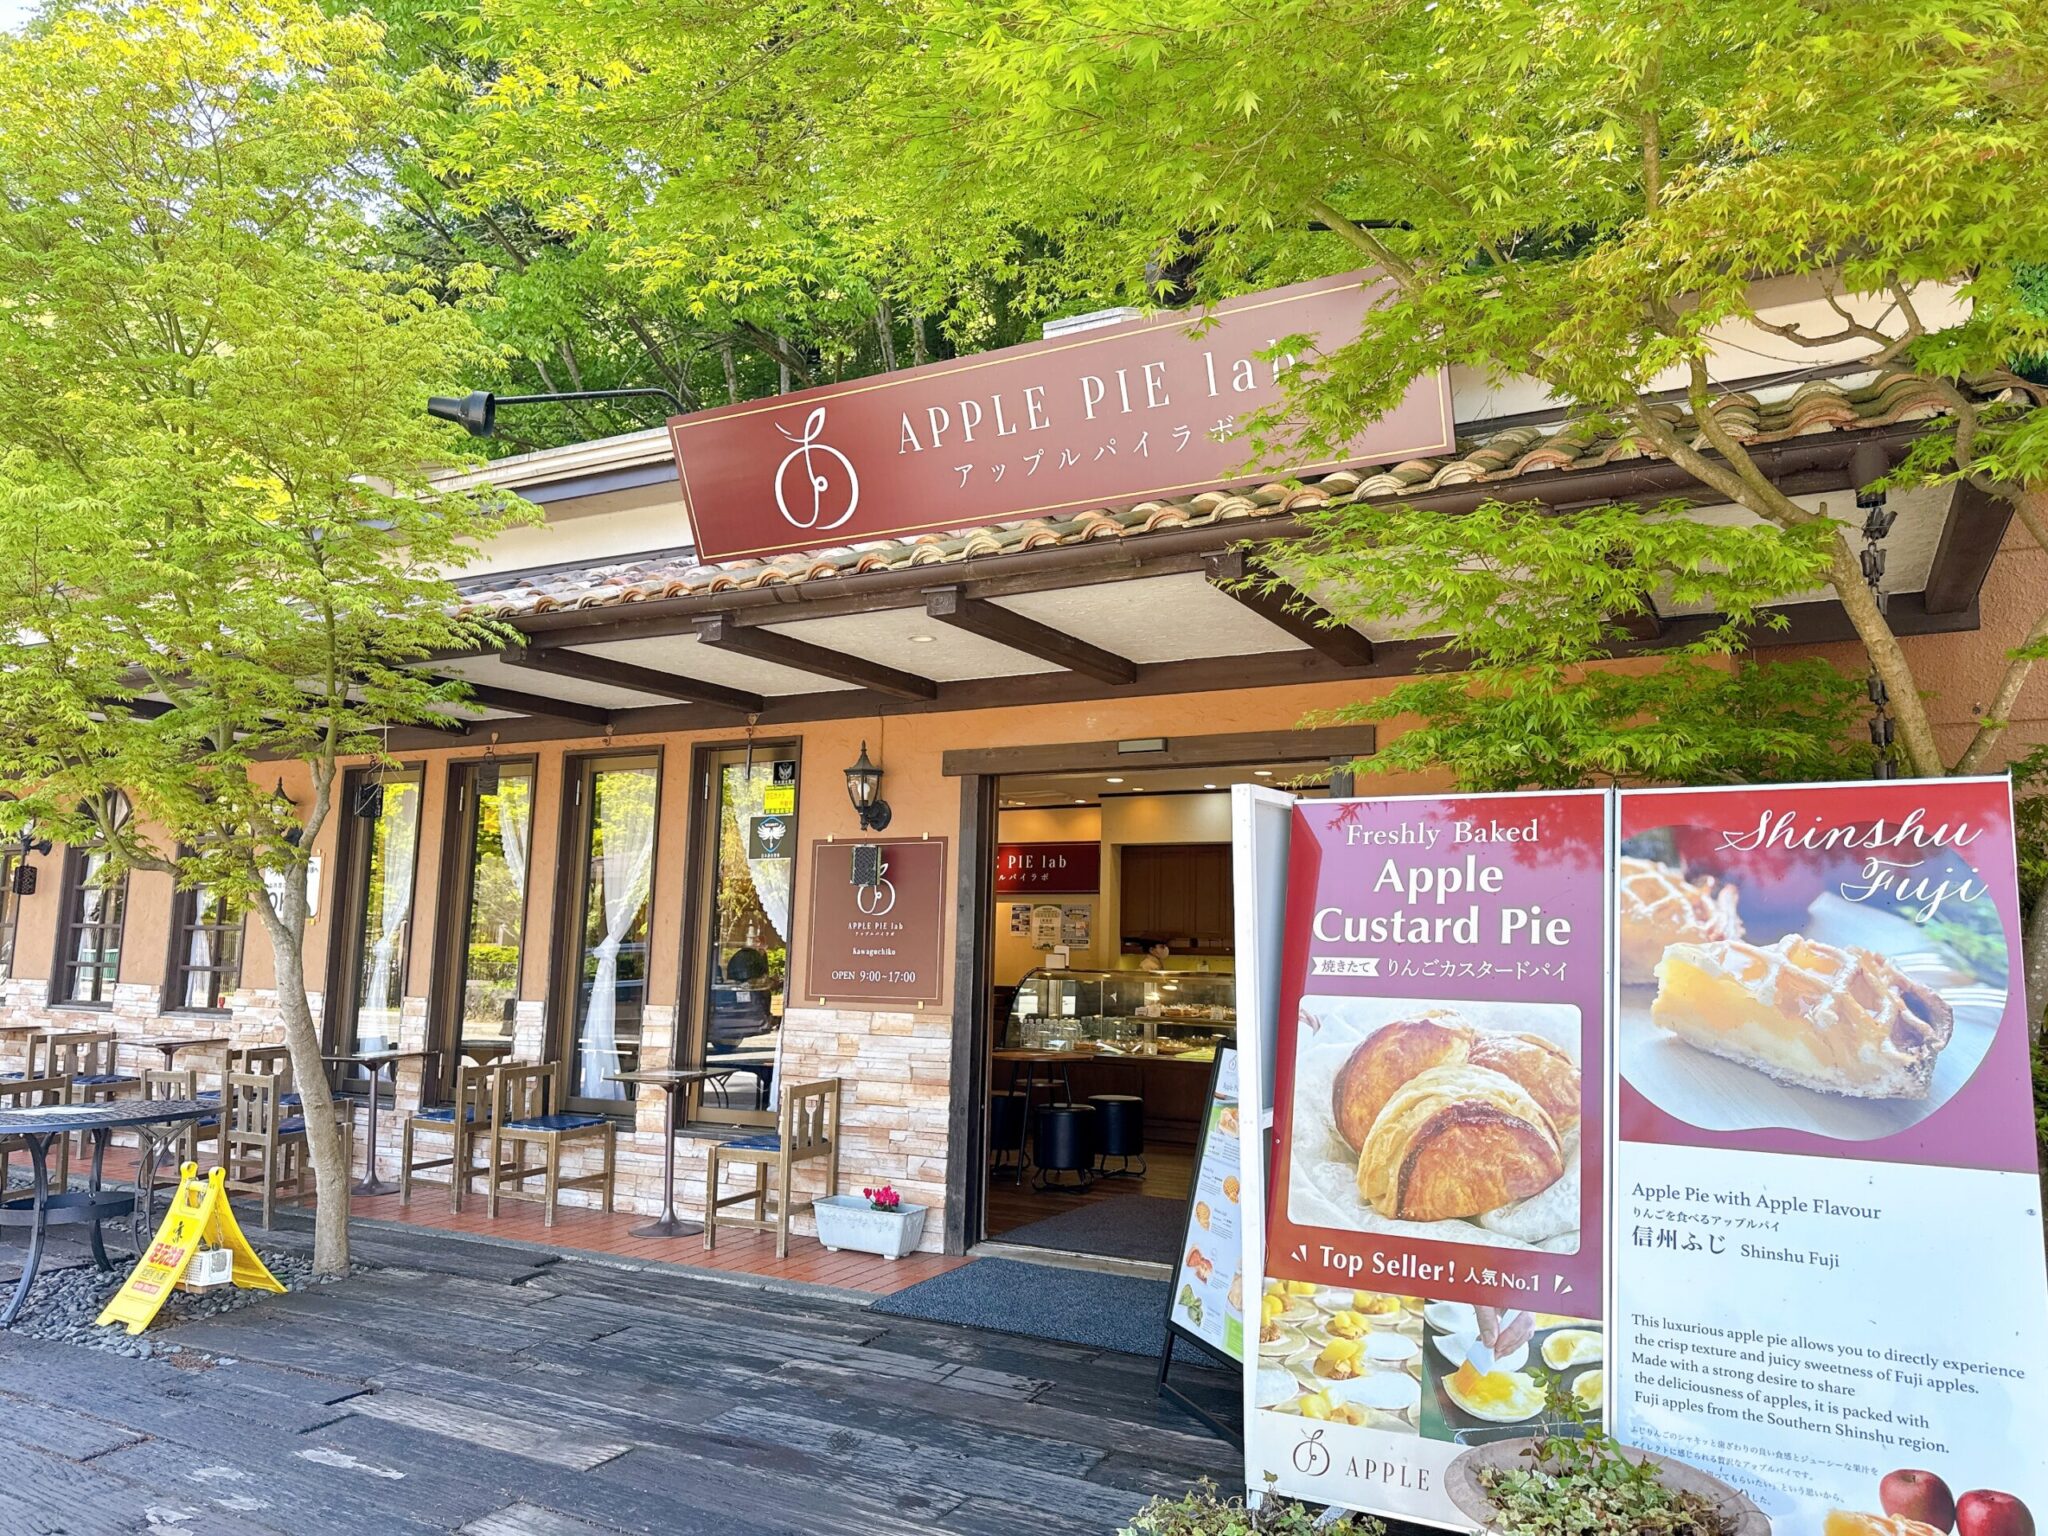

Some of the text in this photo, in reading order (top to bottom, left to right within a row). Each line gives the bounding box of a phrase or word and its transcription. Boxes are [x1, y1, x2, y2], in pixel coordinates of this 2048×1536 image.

[899, 386, 1051, 454] APPLE
[1080, 361, 1170, 420] PIE
[954, 415, 1235, 488] アップルパイラボ
[1346, 819, 1539, 850] Freshly Baked
[1715, 808, 1982, 852] Shinshu
[1008, 855, 1033, 869] PIE
[1042, 855, 1067, 869] lab
[1373, 855, 1504, 904] Apple
[1841, 857, 1990, 922] Fuji
[848, 922, 903, 930] APPLE PIE lab
[1312, 905, 1571, 945] Custard Pie
[853, 947, 896, 957] Kawaguchiko
[1321, 958, 1568, 981] 焼きたて りんごカスタードパイ
[831, 970, 855, 980] OPEN
[1632, 1182, 1881, 1219] Apple Pie with Apple Flavour
[1633, 1207, 1780, 1232] りんごを食べるアップルパイ
[1319, 1245, 1363, 1277] Top
[1632, 1225, 1839, 1270] 信州ふじ Shinshu Fuji
[1632, 1313, 2025, 1379] This luxurious apple pie allows you to directly experience
[1635, 1334, 1979, 1394] the crisp texture and juicy sweetness of Fuji apples.
[1632, 1352, 1855, 1396] Made with a strong desire to share
[1635, 1372, 1929, 1429] the deliciousness of apples, it is packed with
[1635, 1391, 1950, 1453] Fuji apples from the Southern Shinshu region.
[1345, 1456, 1430, 1491] APPLE
